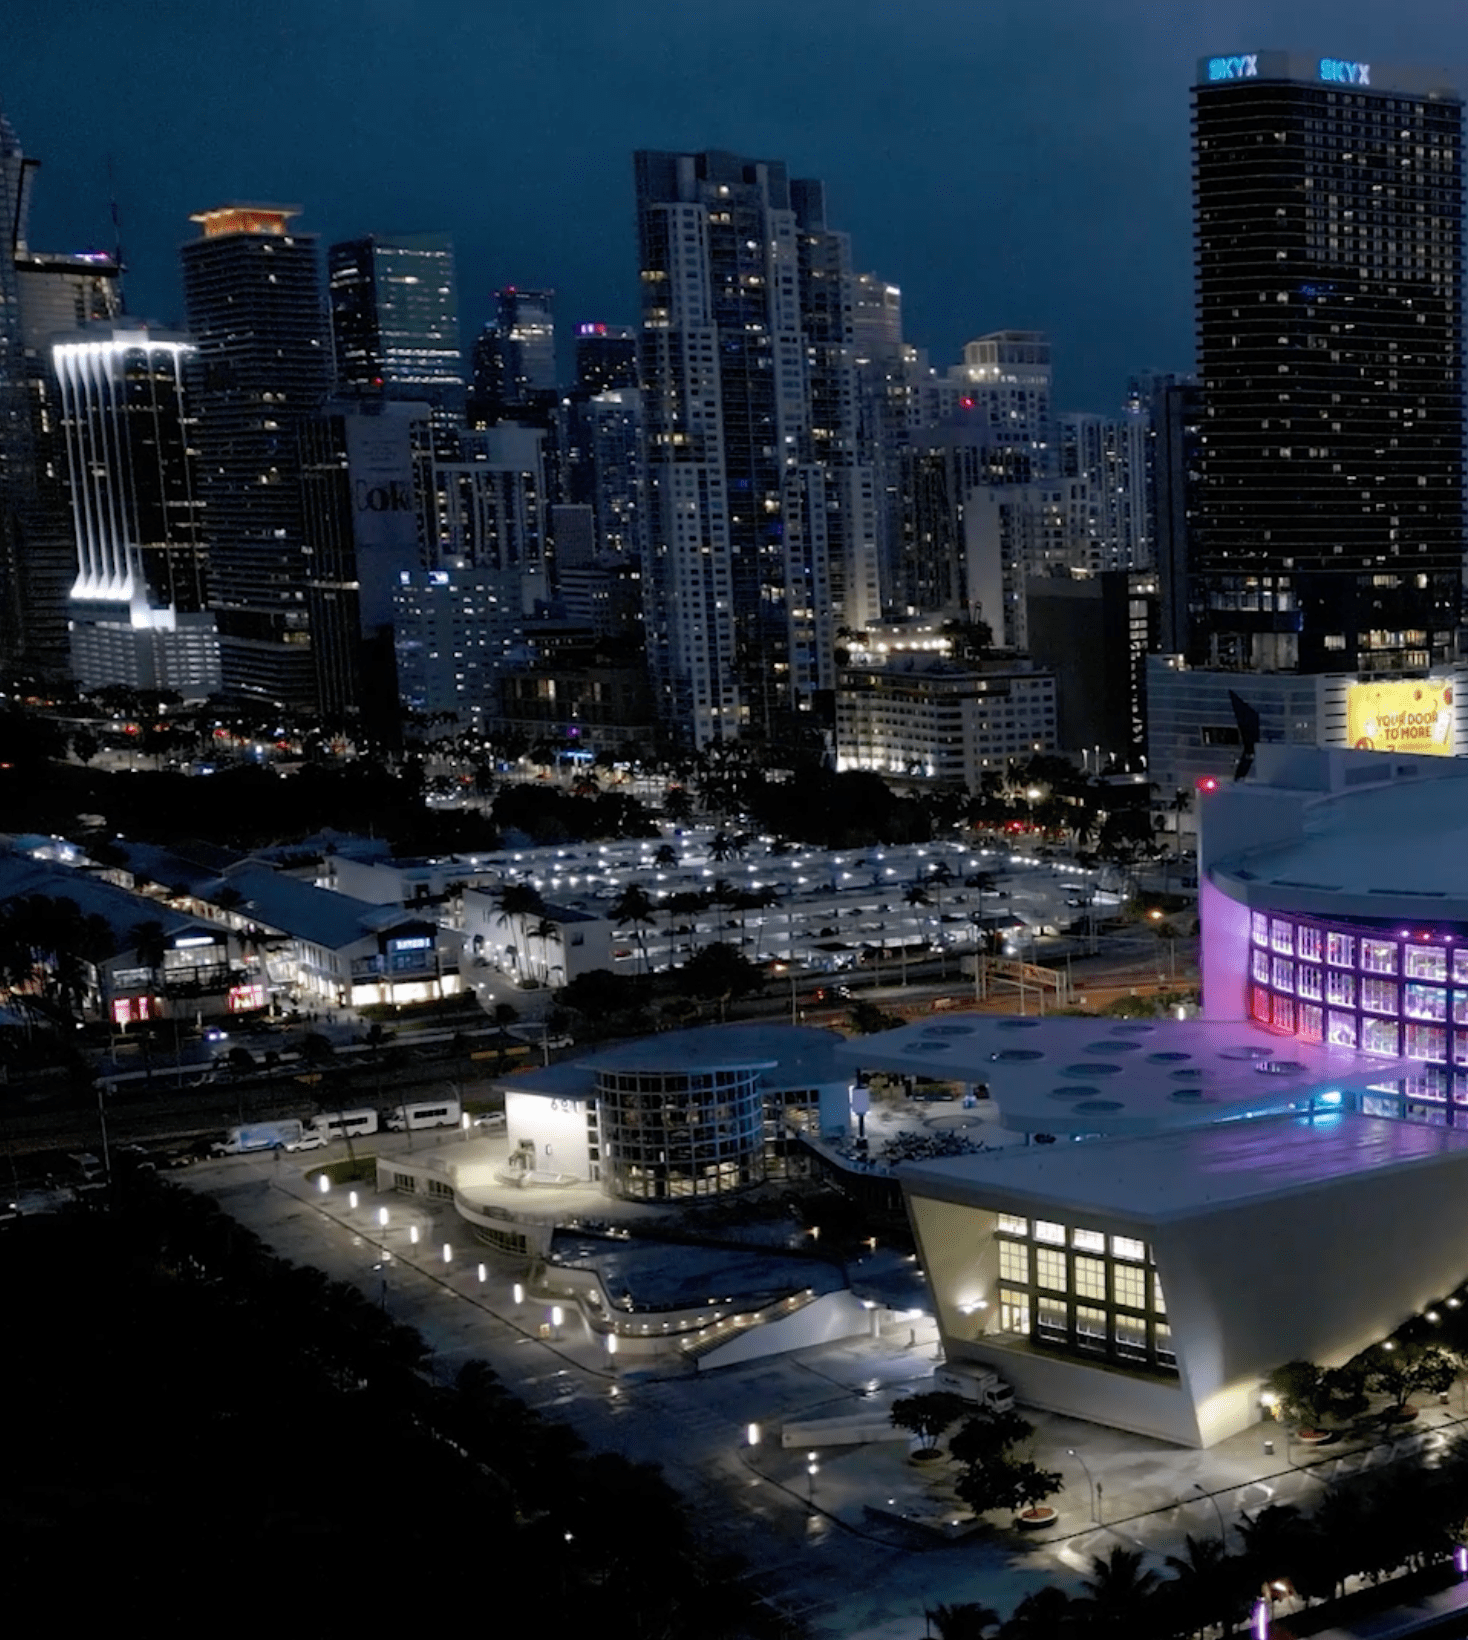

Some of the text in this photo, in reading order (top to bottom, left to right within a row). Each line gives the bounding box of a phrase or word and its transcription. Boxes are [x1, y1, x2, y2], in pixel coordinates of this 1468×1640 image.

[1376, 711, 1438, 727] YOUR DOOR
[1385, 726, 1432, 740] TO MORE
